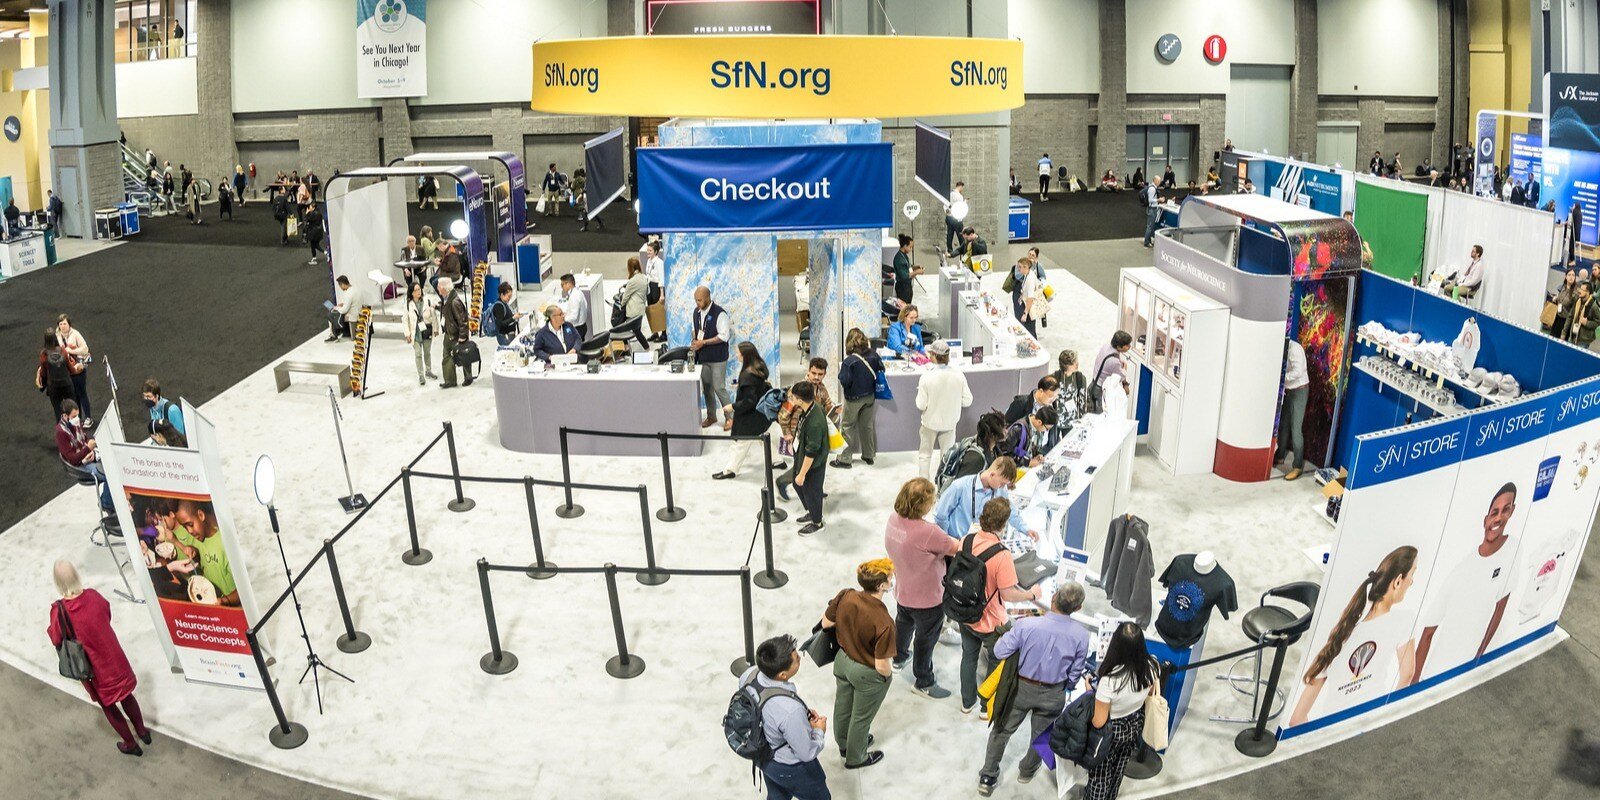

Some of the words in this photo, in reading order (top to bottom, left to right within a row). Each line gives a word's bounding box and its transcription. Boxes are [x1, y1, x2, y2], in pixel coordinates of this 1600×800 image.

[362, 45, 374, 55] See
[375, 44, 387, 55] You
[388, 43, 404, 54] Next
[406, 42, 420, 53] Year
[373, 57, 380, 68] in
[381, 56, 409, 69] Chicago!
[545, 63, 600, 94] SfN.org
[711, 60, 832, 96] SfN.org
[950, 60, 1008, 91] SfN.org
[699, 177, 832, 202] Checkout
[468, 197, 484, 212] eNeuro
[1160, 250, 1180, 268] SOCIETY
[1187, 262, 1227, 292] NEUROSCIENCE
[1475, 419, 1501, 447] SfN
[1505, 408, 1547, 434] STORE
[131, 456, 145, 467] The
[146, 459, 164, 468] brain
[165, 461, 172, 469] is
[172, 461, 185, 470] the
[1374, 444, 1402, 474] SfN
[1411, 431, 1461, 460] STORE
[122, 466, 159, 478] foundation
[159, 470, 167, 479] of
[168, 472, 180, 480] the
[181, 474, 200, 482] mind
[174, 619, 239, 635] Neuroscience
[176, 630, 199, 641] Core
[200, 633, 247, 647] Concepts
